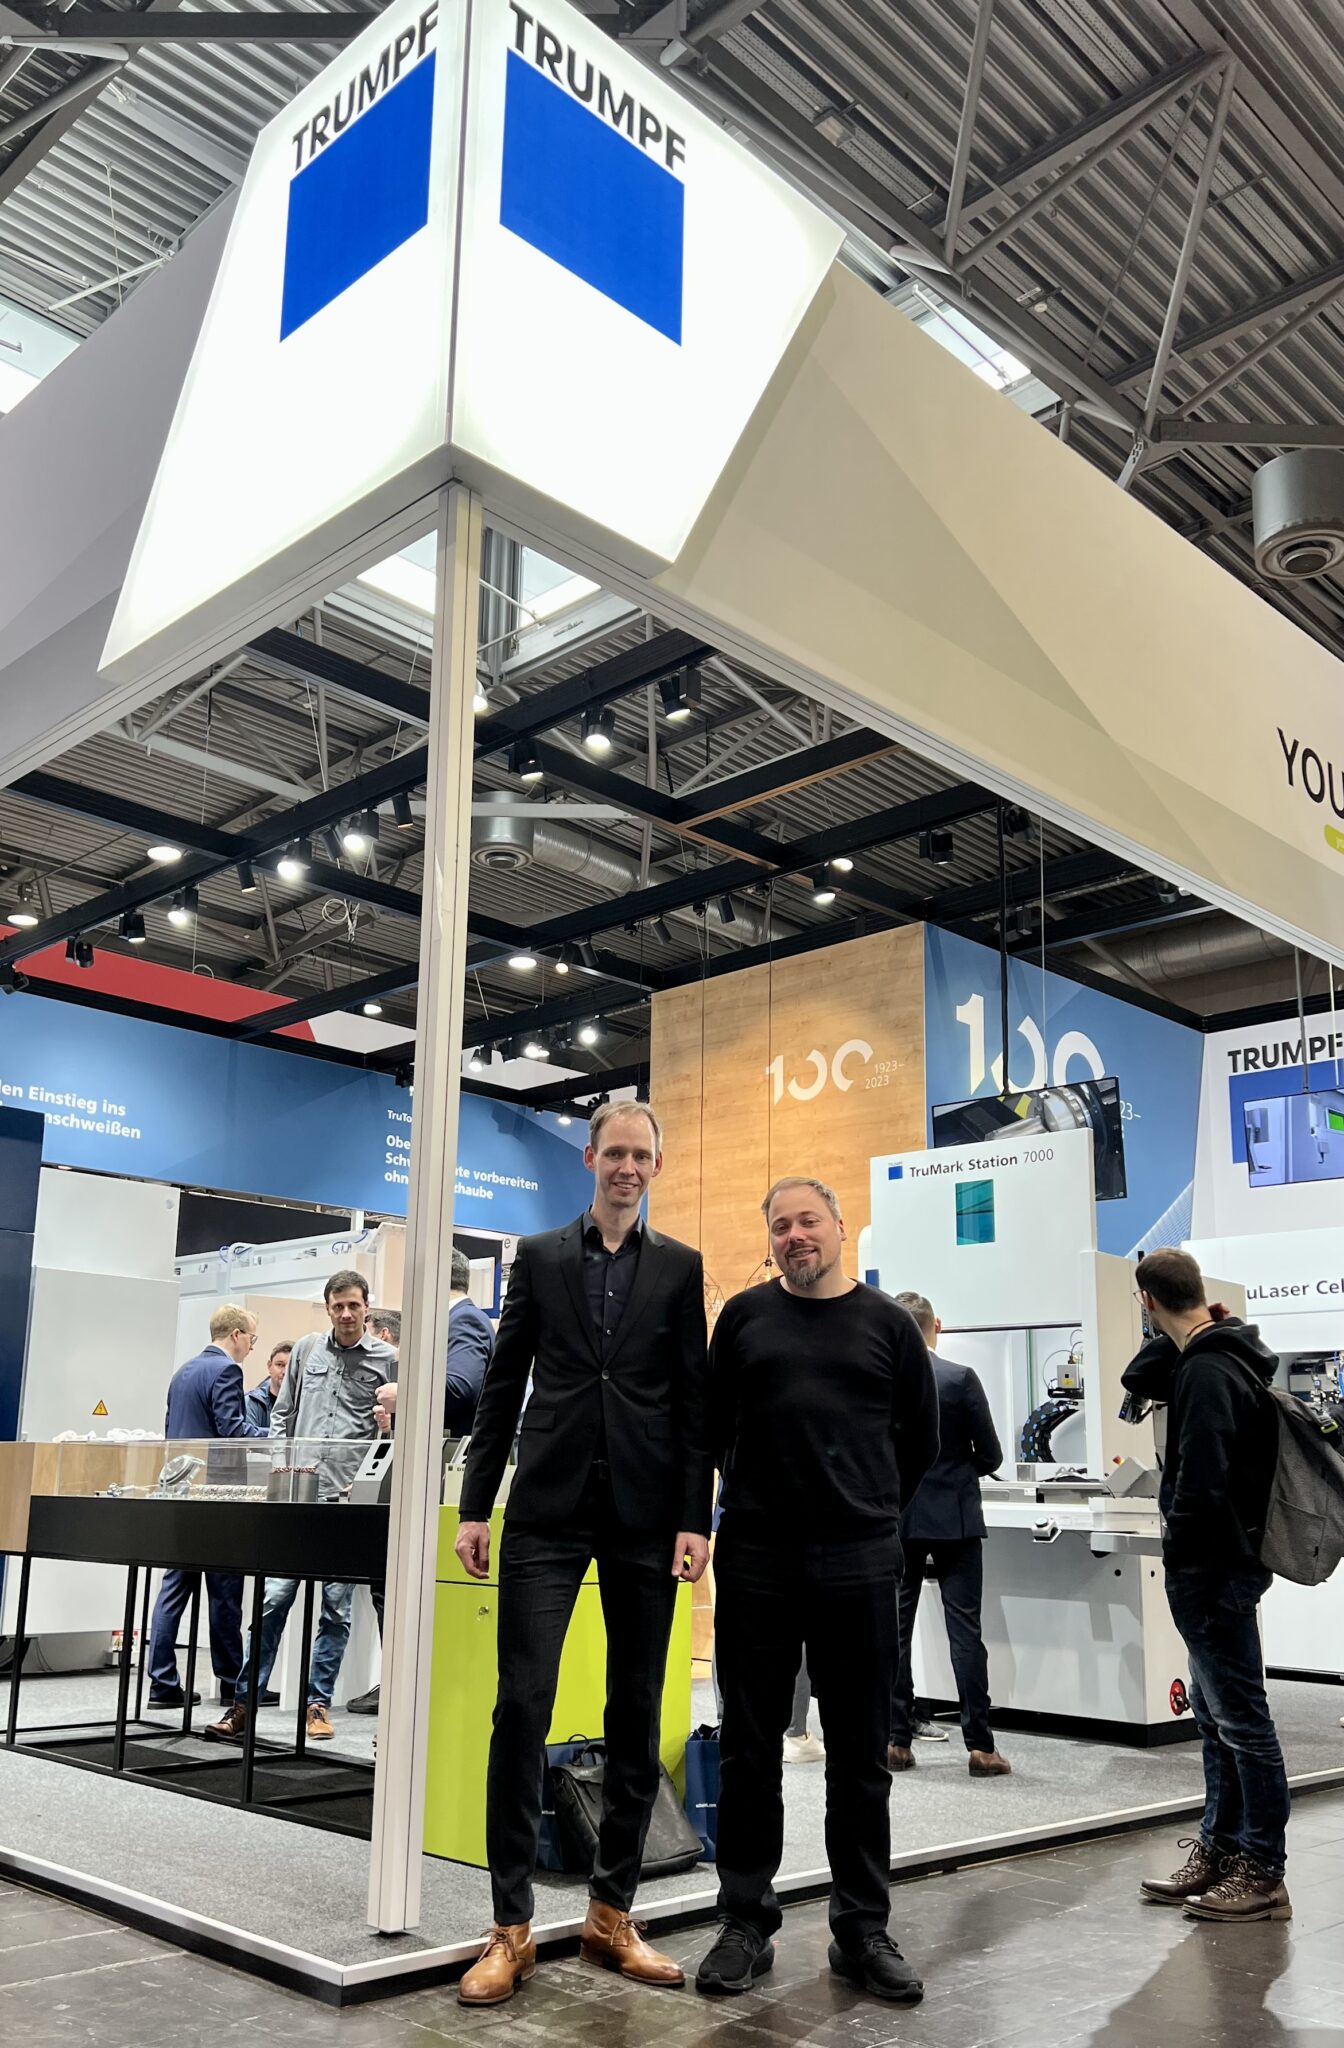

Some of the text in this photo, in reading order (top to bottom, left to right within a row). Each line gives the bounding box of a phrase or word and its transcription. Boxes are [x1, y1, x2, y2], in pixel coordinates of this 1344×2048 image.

[292, 0, 439, 171] TRUMPF
[509, 0, 686, 171] TRUMPF
[1227, 1032, 1344, 1073] TRUMPF
[865, 1075, 889, 1089] 2023
[0, 1079, 126, 1116] en Einstieg ins
[44, 1112, 141, 1139] nschweißen
[387, 1110, 413, 1123] TruTo
[386, 1135, 411, 1150] Obe
[909, 1148, 1054, 1178] TruMark Station 7000
[384, 1170, 409, 1185] ohn
[473, 1171, 538, 1191] vorbereiten
[1247, 1278, 1344, 1300] uLaser Cel
